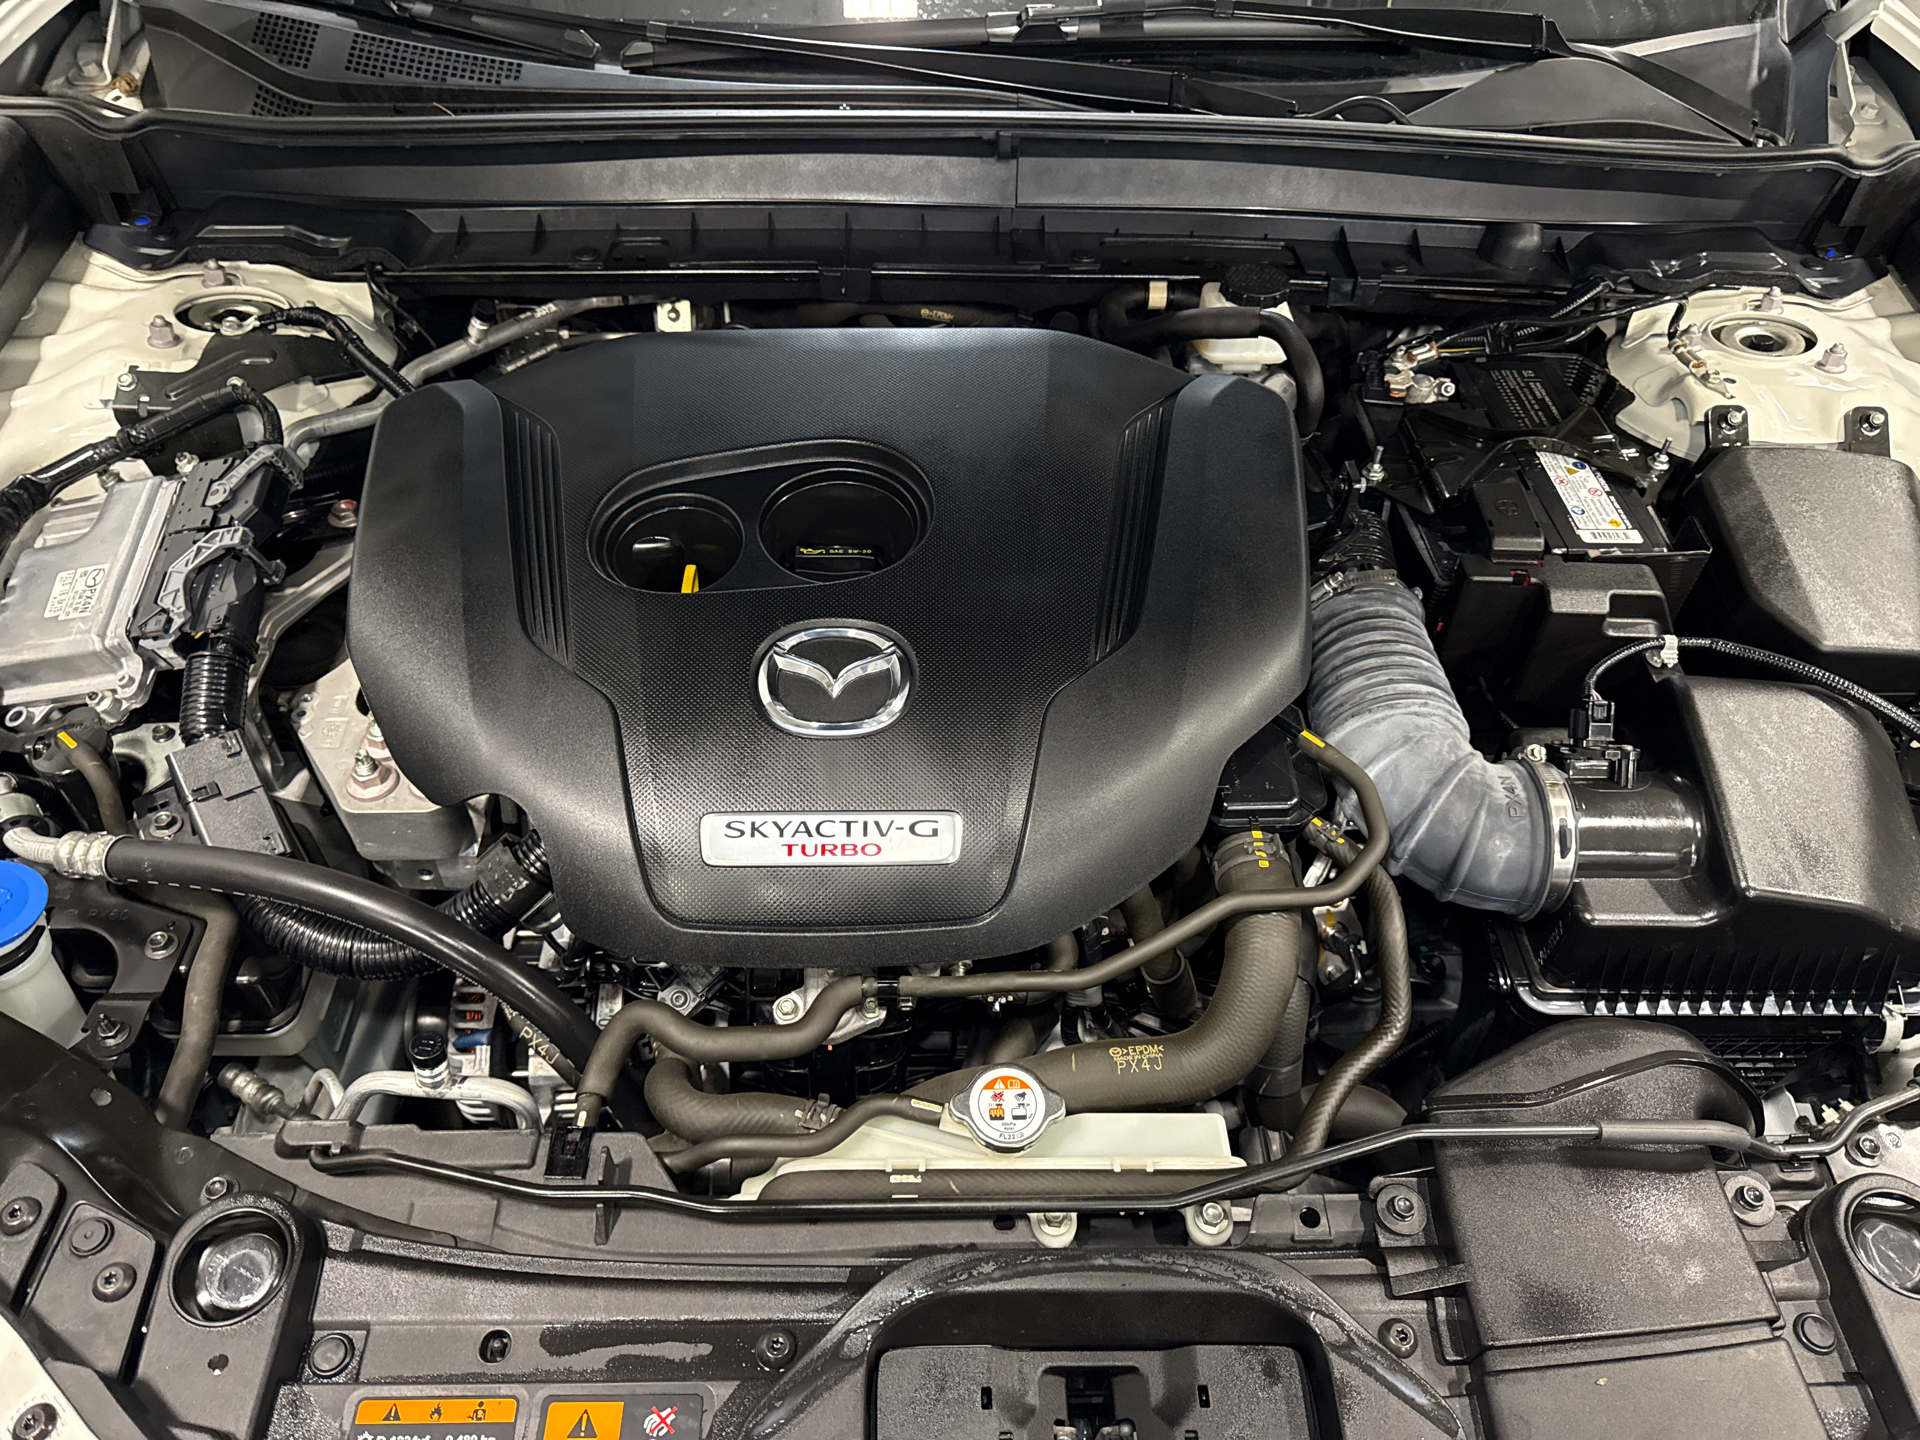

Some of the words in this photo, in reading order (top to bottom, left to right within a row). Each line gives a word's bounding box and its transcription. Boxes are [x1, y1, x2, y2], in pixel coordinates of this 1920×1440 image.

[723, 819, 940, 839] SKYACTIV-G
[781, 843, 882, 858] TURBO
[518, 1026, 560, 1064] PX4J
[999, 1132, 1016, 1140] FL22
